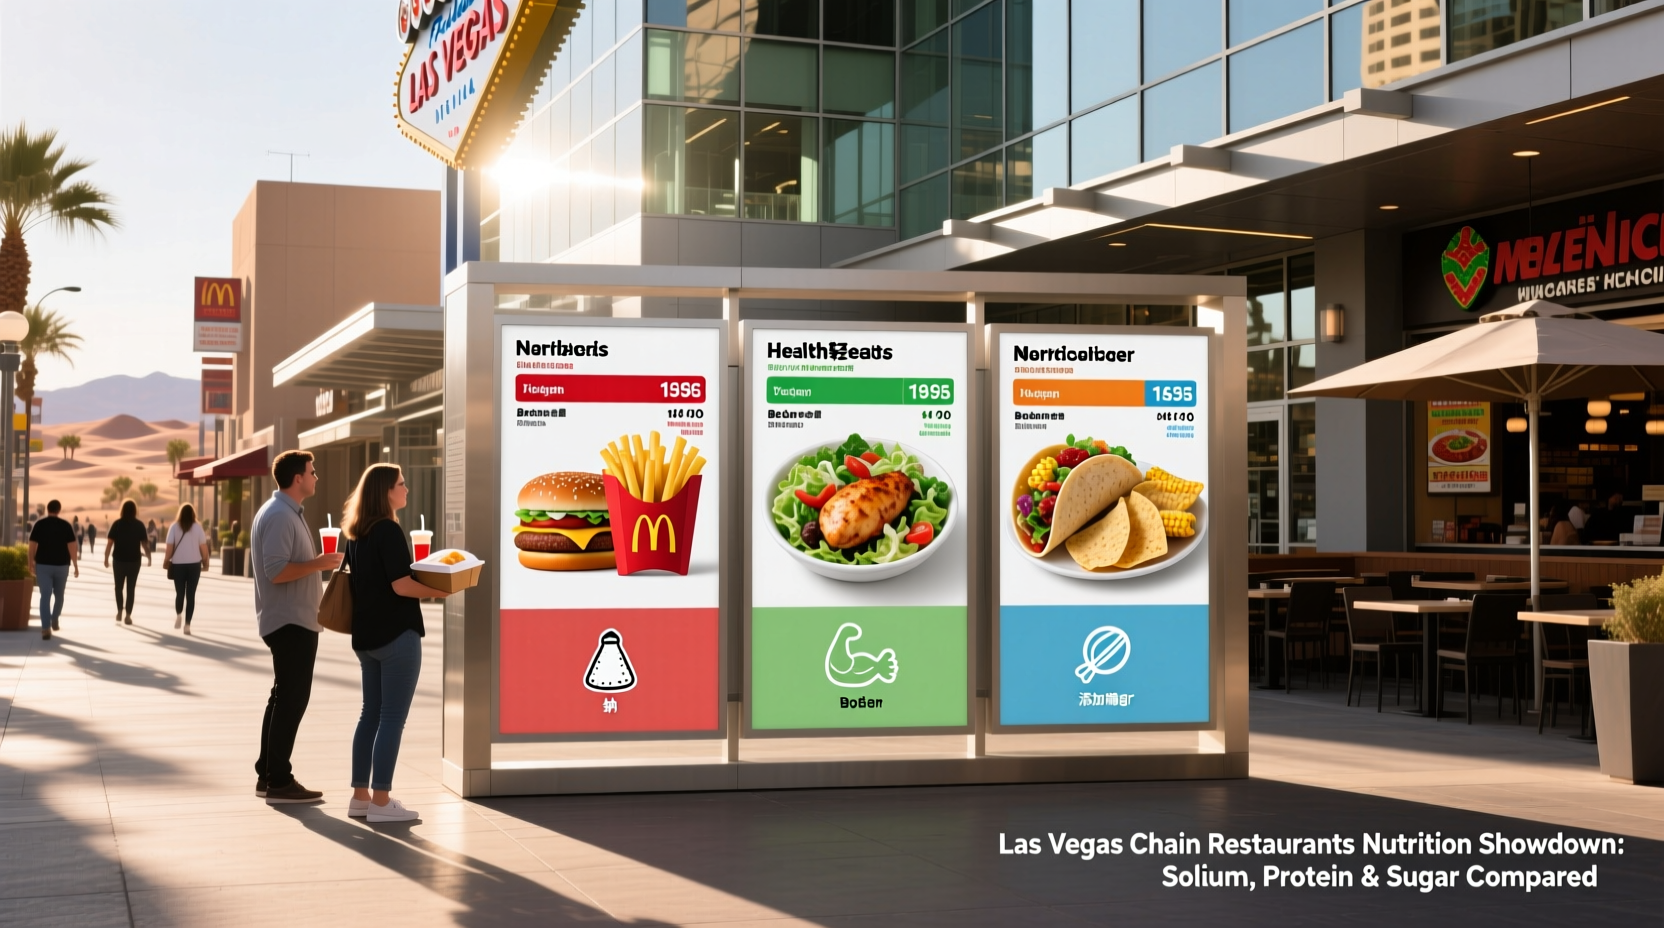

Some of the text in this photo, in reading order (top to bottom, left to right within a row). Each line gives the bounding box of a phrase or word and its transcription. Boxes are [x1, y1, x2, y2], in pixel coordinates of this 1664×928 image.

[409, 50, 440, 114] LAS
[441, 0, 509, 82] VEGAS
[909, 383, 951, 400] 1995
